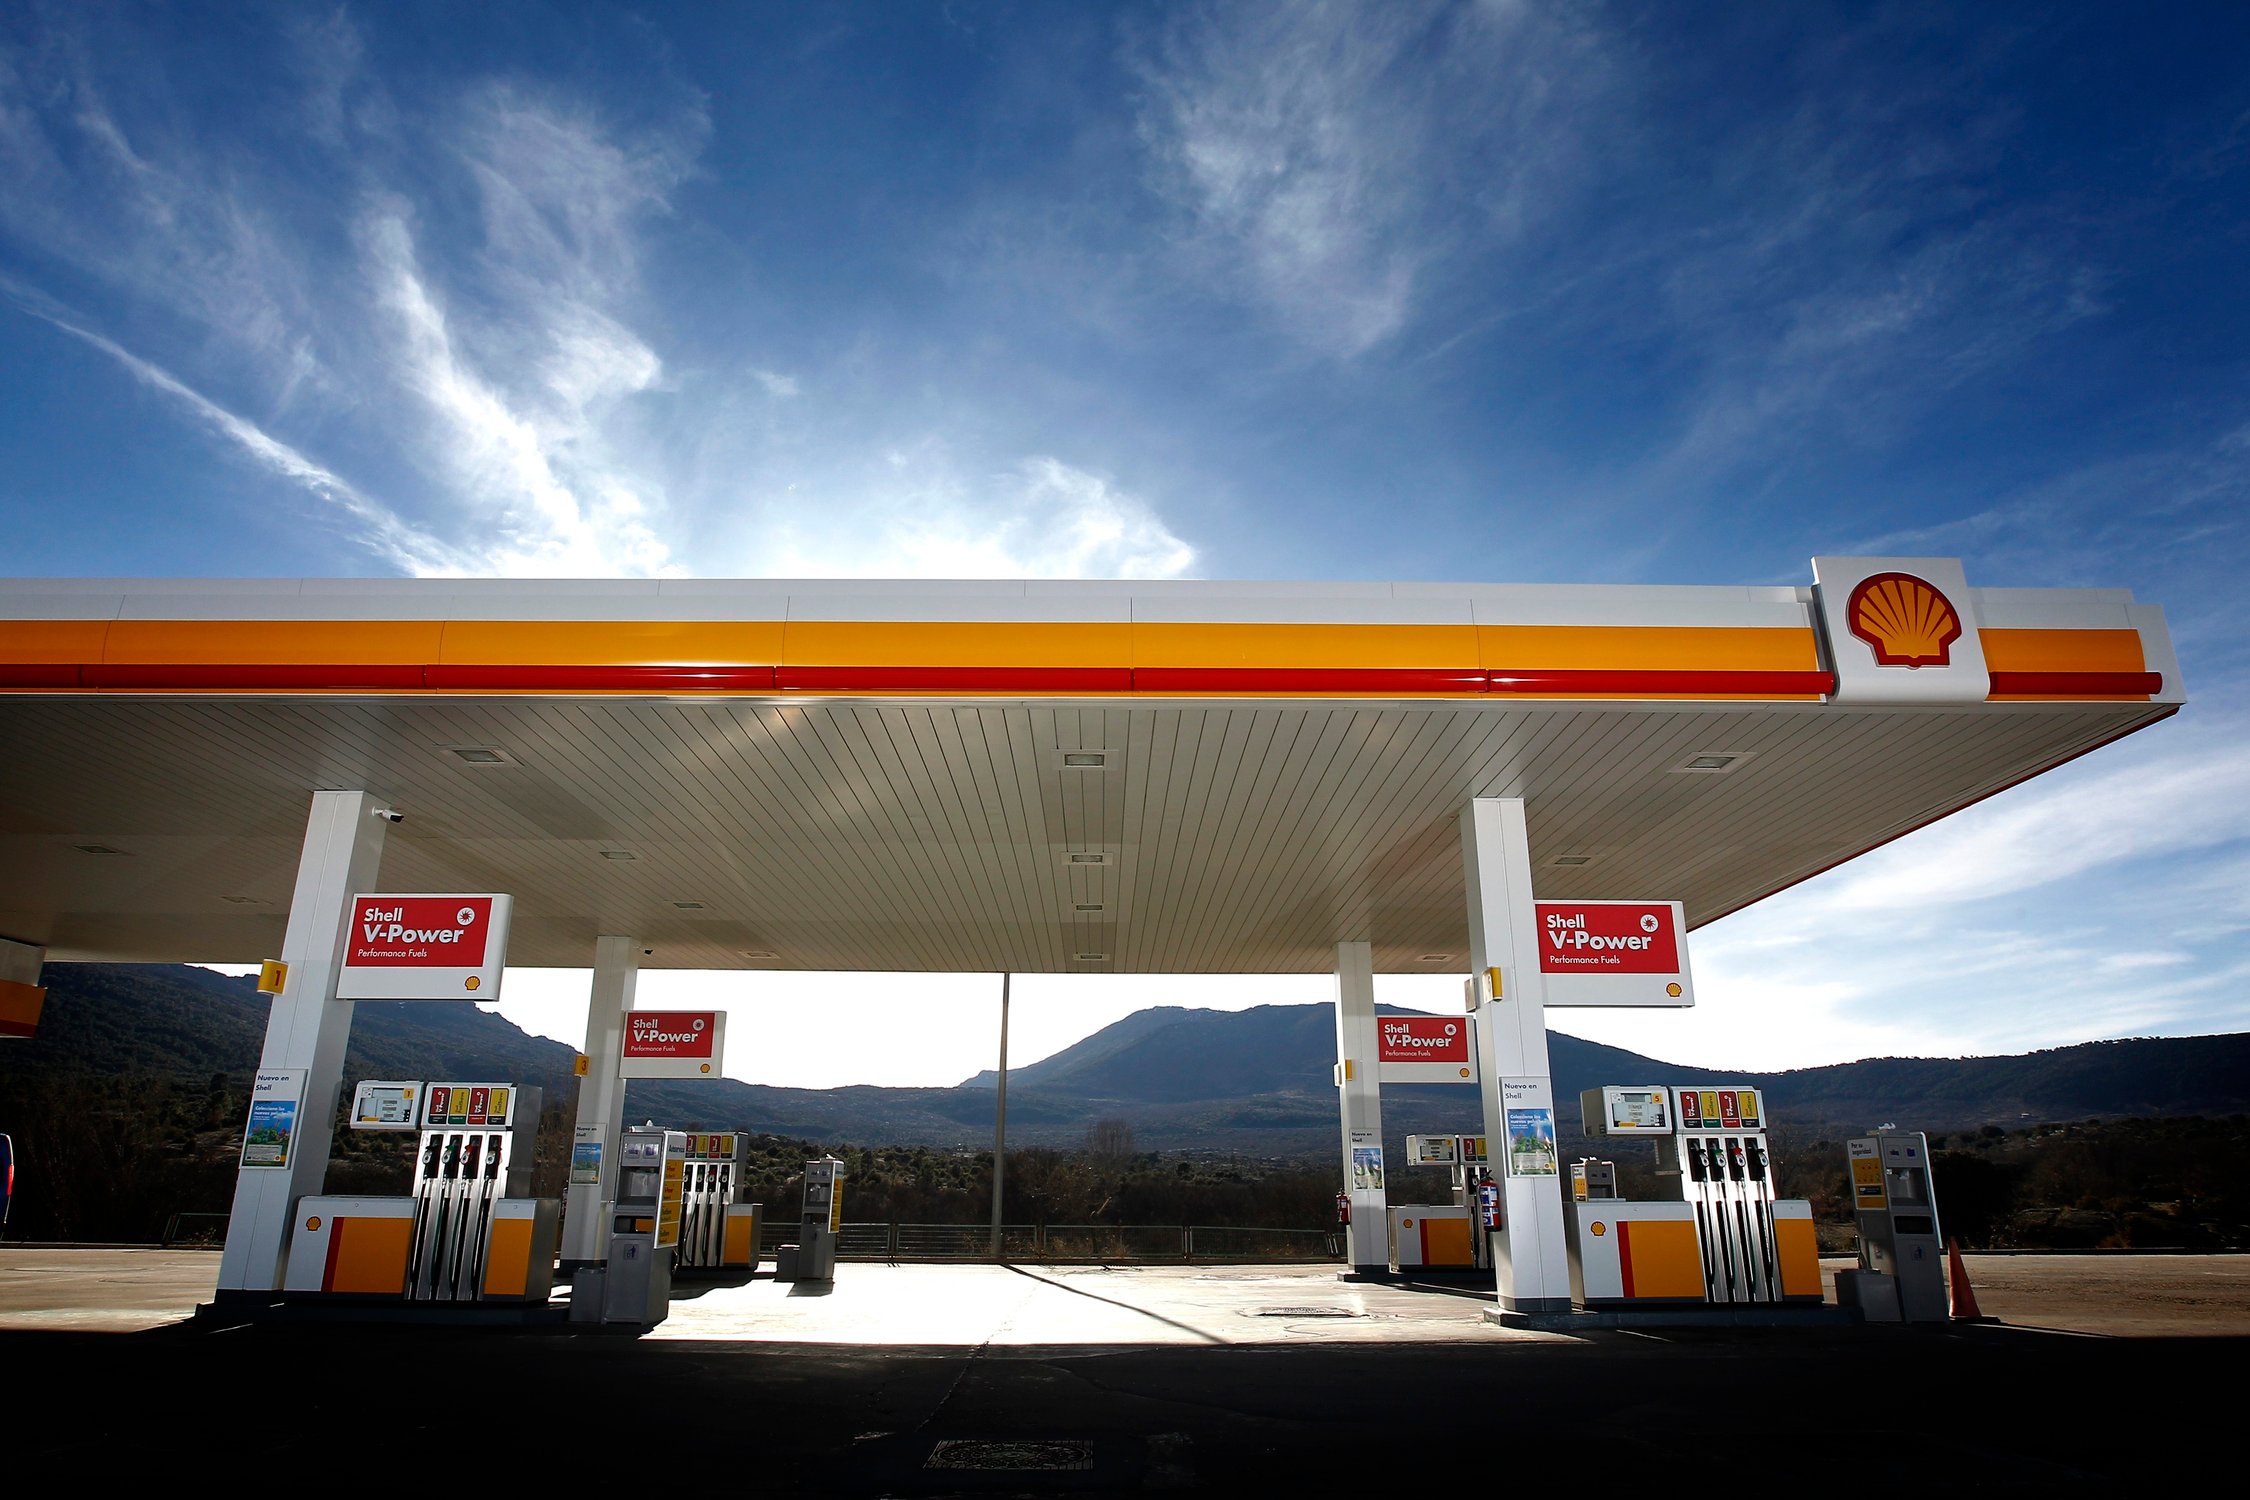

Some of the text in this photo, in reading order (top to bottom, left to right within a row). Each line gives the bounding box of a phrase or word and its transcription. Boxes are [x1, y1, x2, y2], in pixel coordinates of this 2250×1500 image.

[364, 907, 403, 922] Shell
[1546, 914, 1585, 929] Shell
[363, 924, 464, 943] V-Power
[1548, 930, 1652, 950] V-Power
[357, 947, 427, 958] Performance Fuels
[1550, 955, 1621, 964] Performance Fuels
[274, 969, 282, 987] 1
[633, 1019, 658, 1028] Shell
[1384, 1024, 1409, 1034] Shell
[633, 1029, 698, 1042] V-Power
[1385, 1034, 1452, 1047] V-Power
